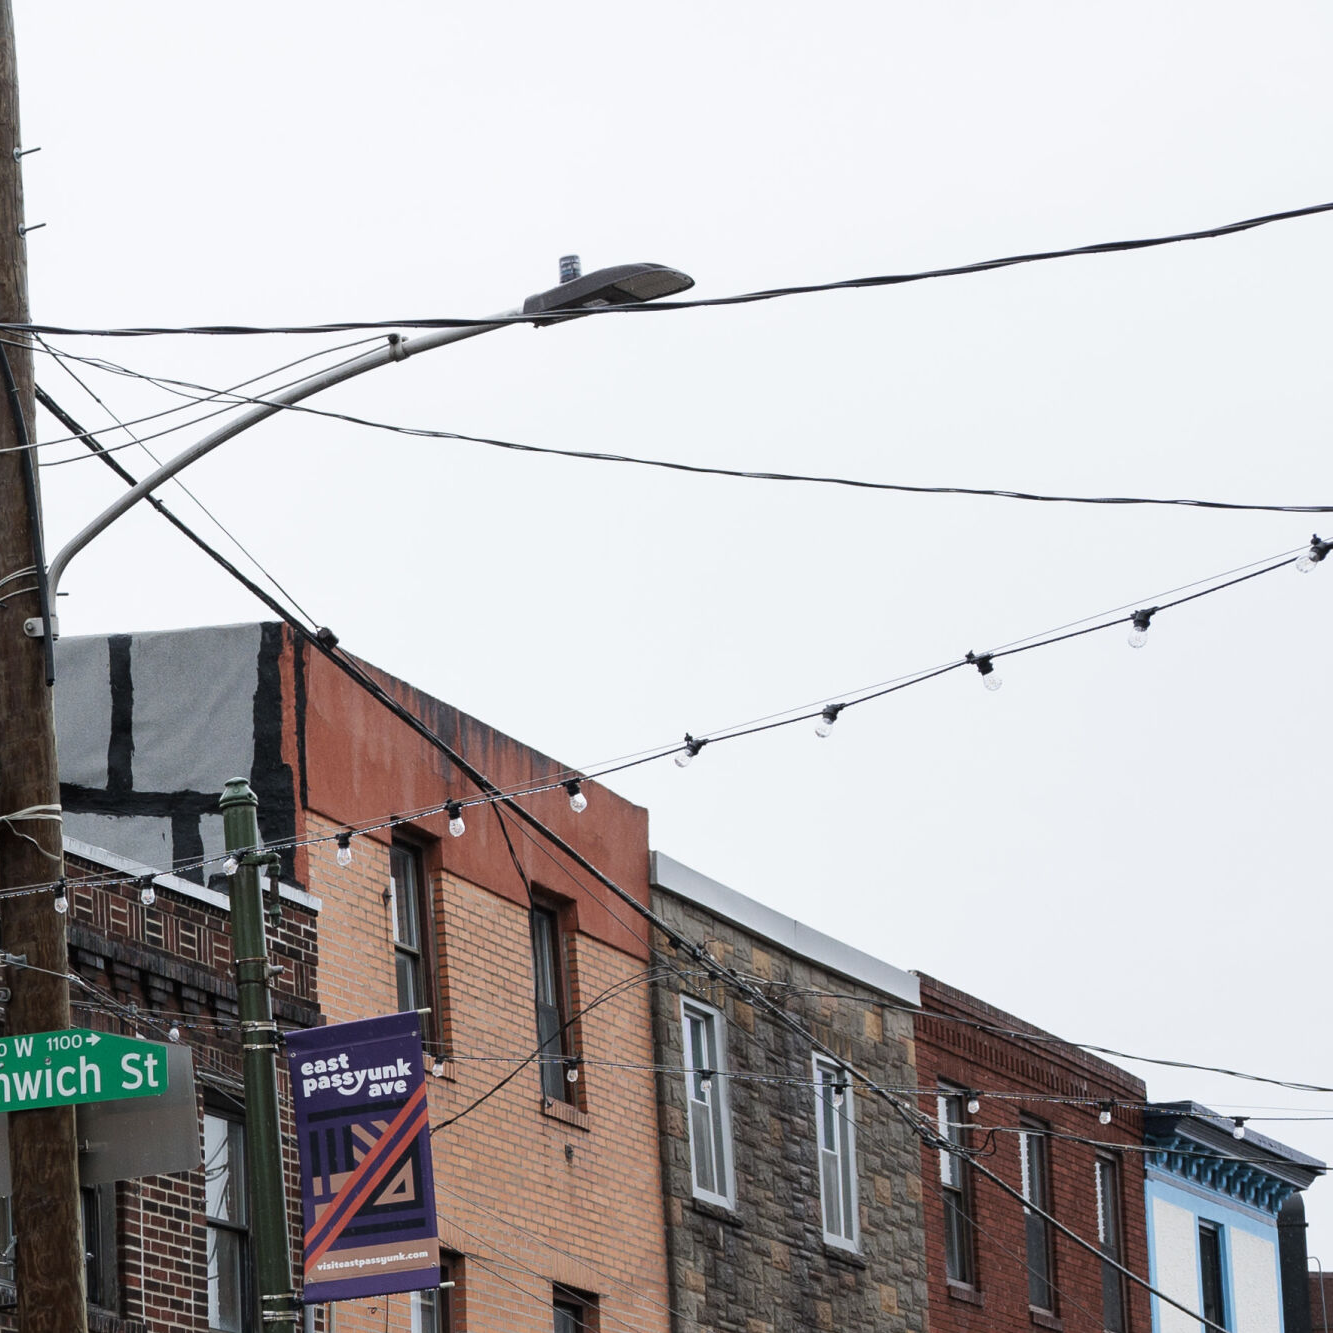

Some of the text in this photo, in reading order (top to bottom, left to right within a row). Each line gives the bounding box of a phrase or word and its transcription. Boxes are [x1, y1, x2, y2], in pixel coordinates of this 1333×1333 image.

[13, 1036, 34, 1058] W
[45, 1034, 83, 1052] 1100
[120, 1053, 160, 1090] St
[300, 1053, 350, 1076] east
[302, 1058, 413, 1098] passyunk
[368, 1079, 408, 1098] ave
[316, 1250, 429, 1271] visiteastpassyunk.com
